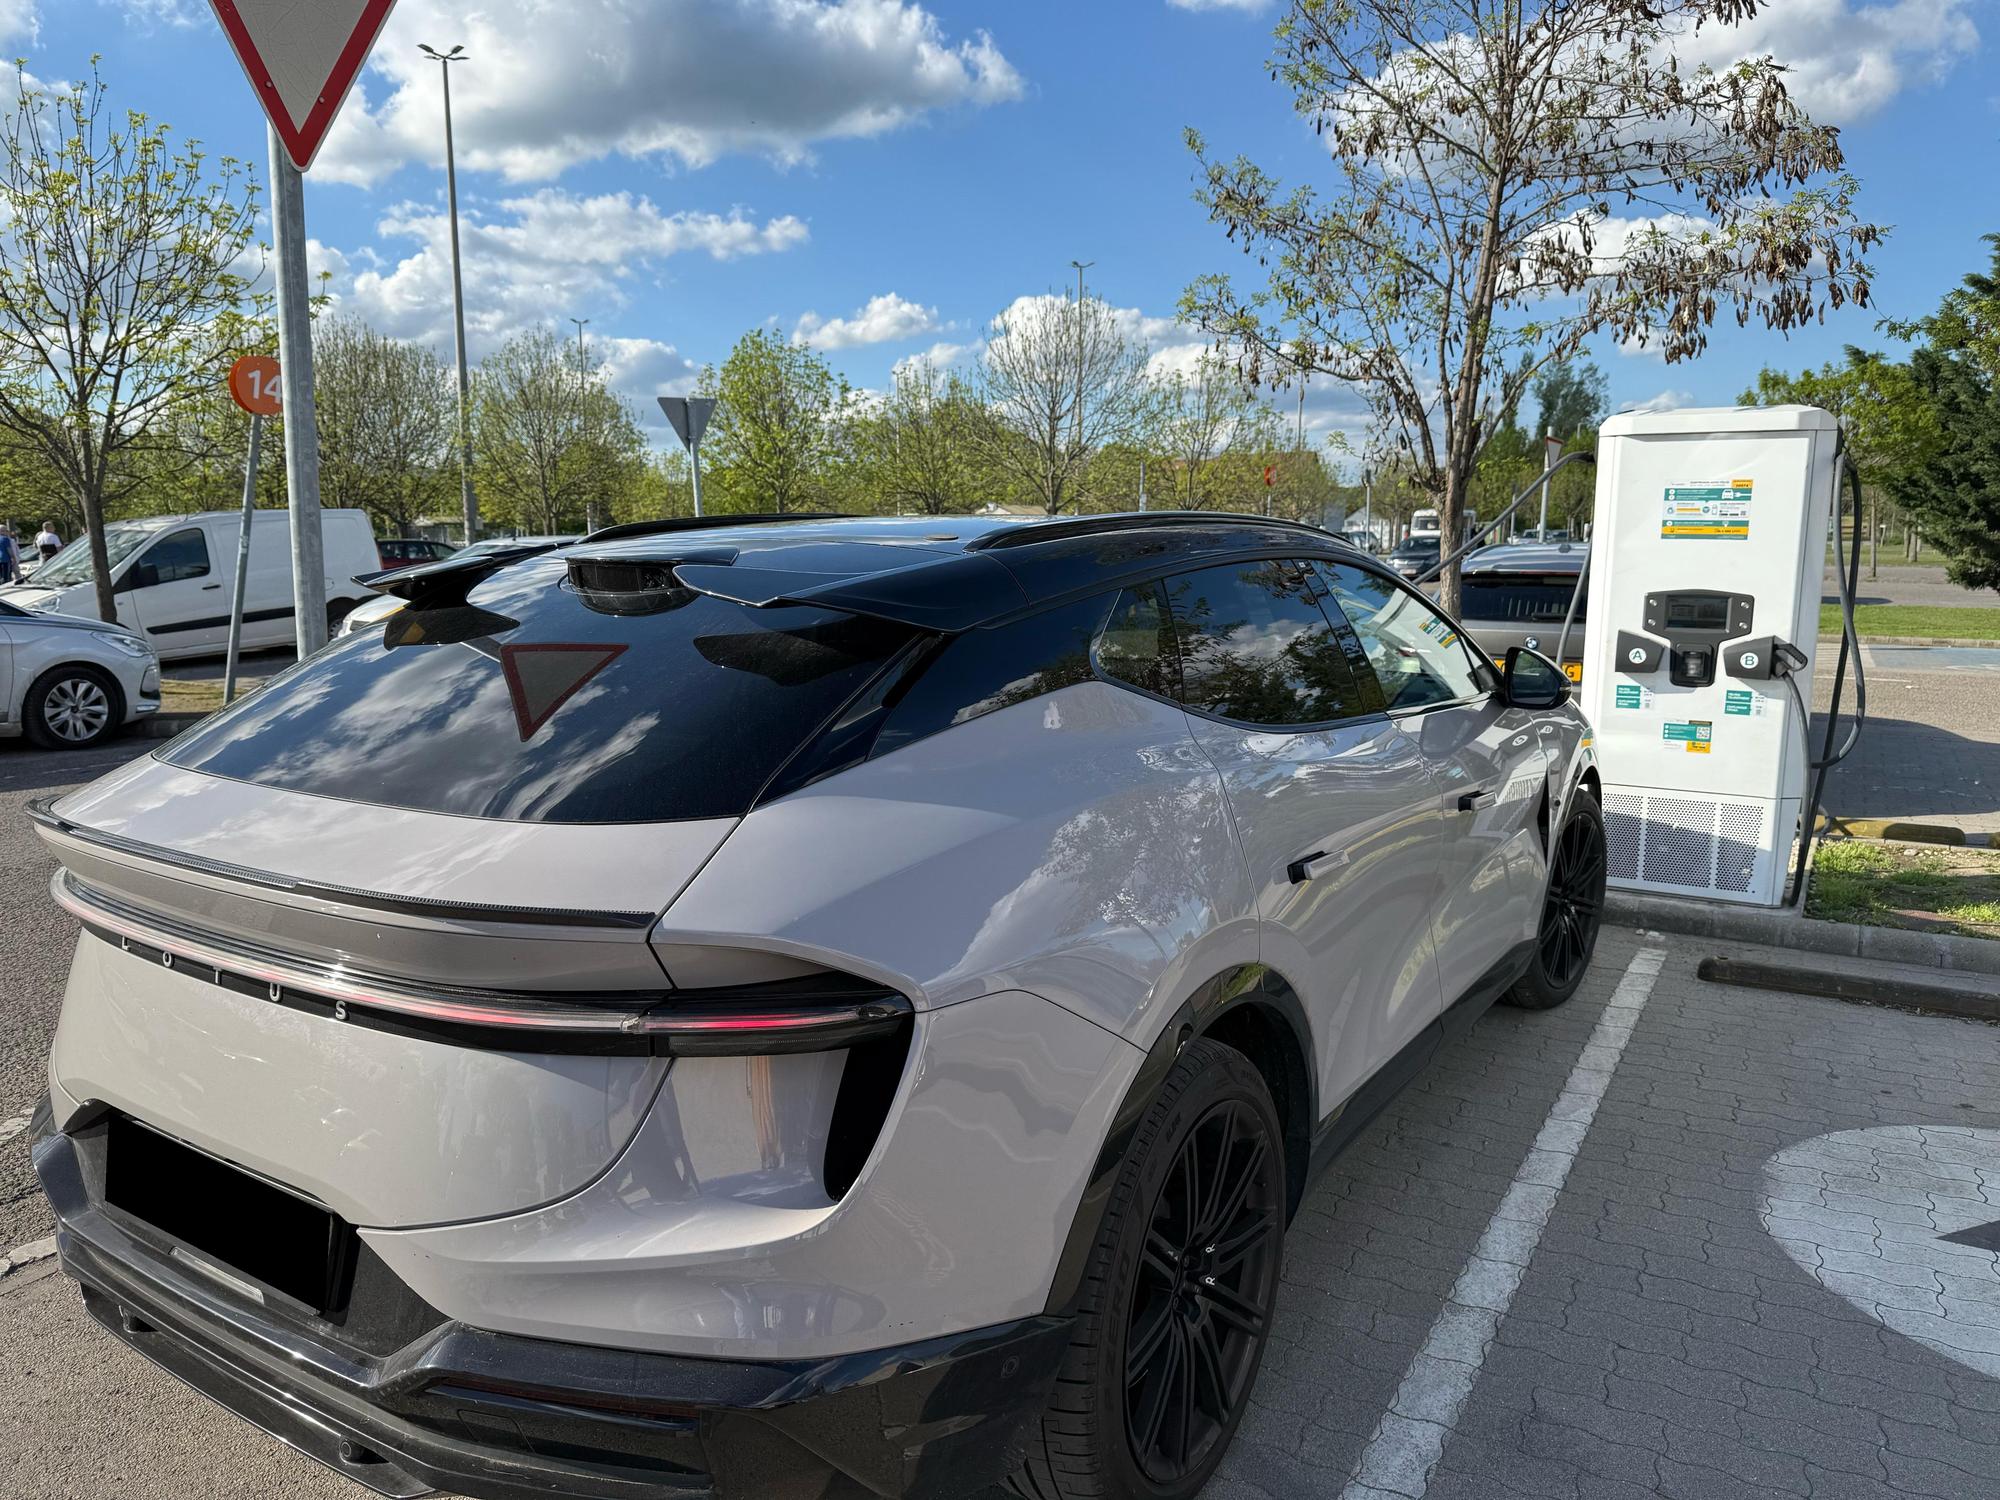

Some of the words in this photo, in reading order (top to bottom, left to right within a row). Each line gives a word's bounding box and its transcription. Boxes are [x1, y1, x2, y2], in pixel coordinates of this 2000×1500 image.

[247, 369, 282, 405] 14
[1632, 650, 1642, 661] A
[1745, 655, 1755, 666] B
[121, 935, 347, 1020] LOTUS
